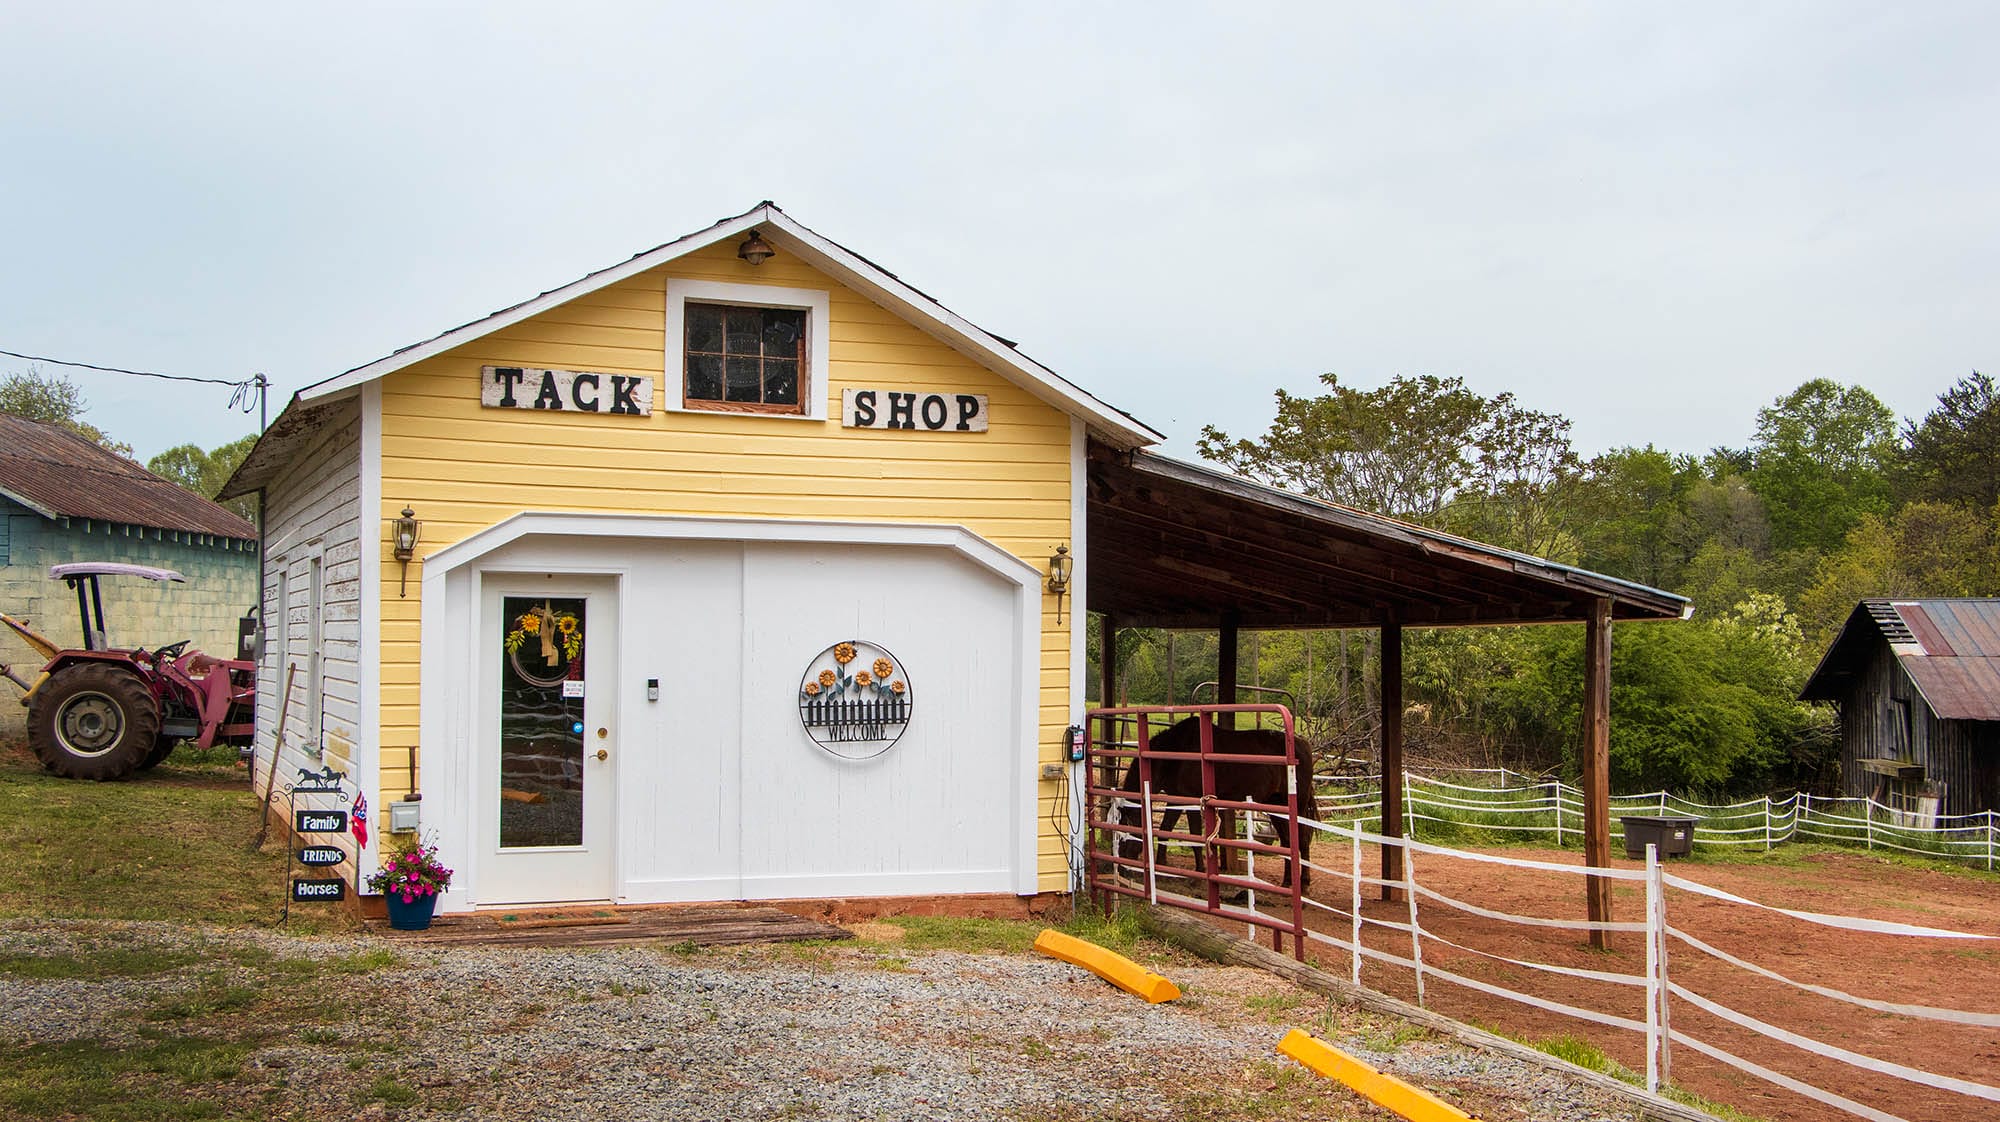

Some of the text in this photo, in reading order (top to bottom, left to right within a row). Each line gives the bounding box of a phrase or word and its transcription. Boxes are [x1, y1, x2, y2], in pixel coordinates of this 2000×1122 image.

[495, 368, 641, 415] TACK
[855, 391, 979, 430] SHOP
[828, 723, 887, 741] WELCOME
[303, 815, 340, 830] Family
[303, 851, 343, 862] FRIENDS
[298, 883, 339, 895] Horses
